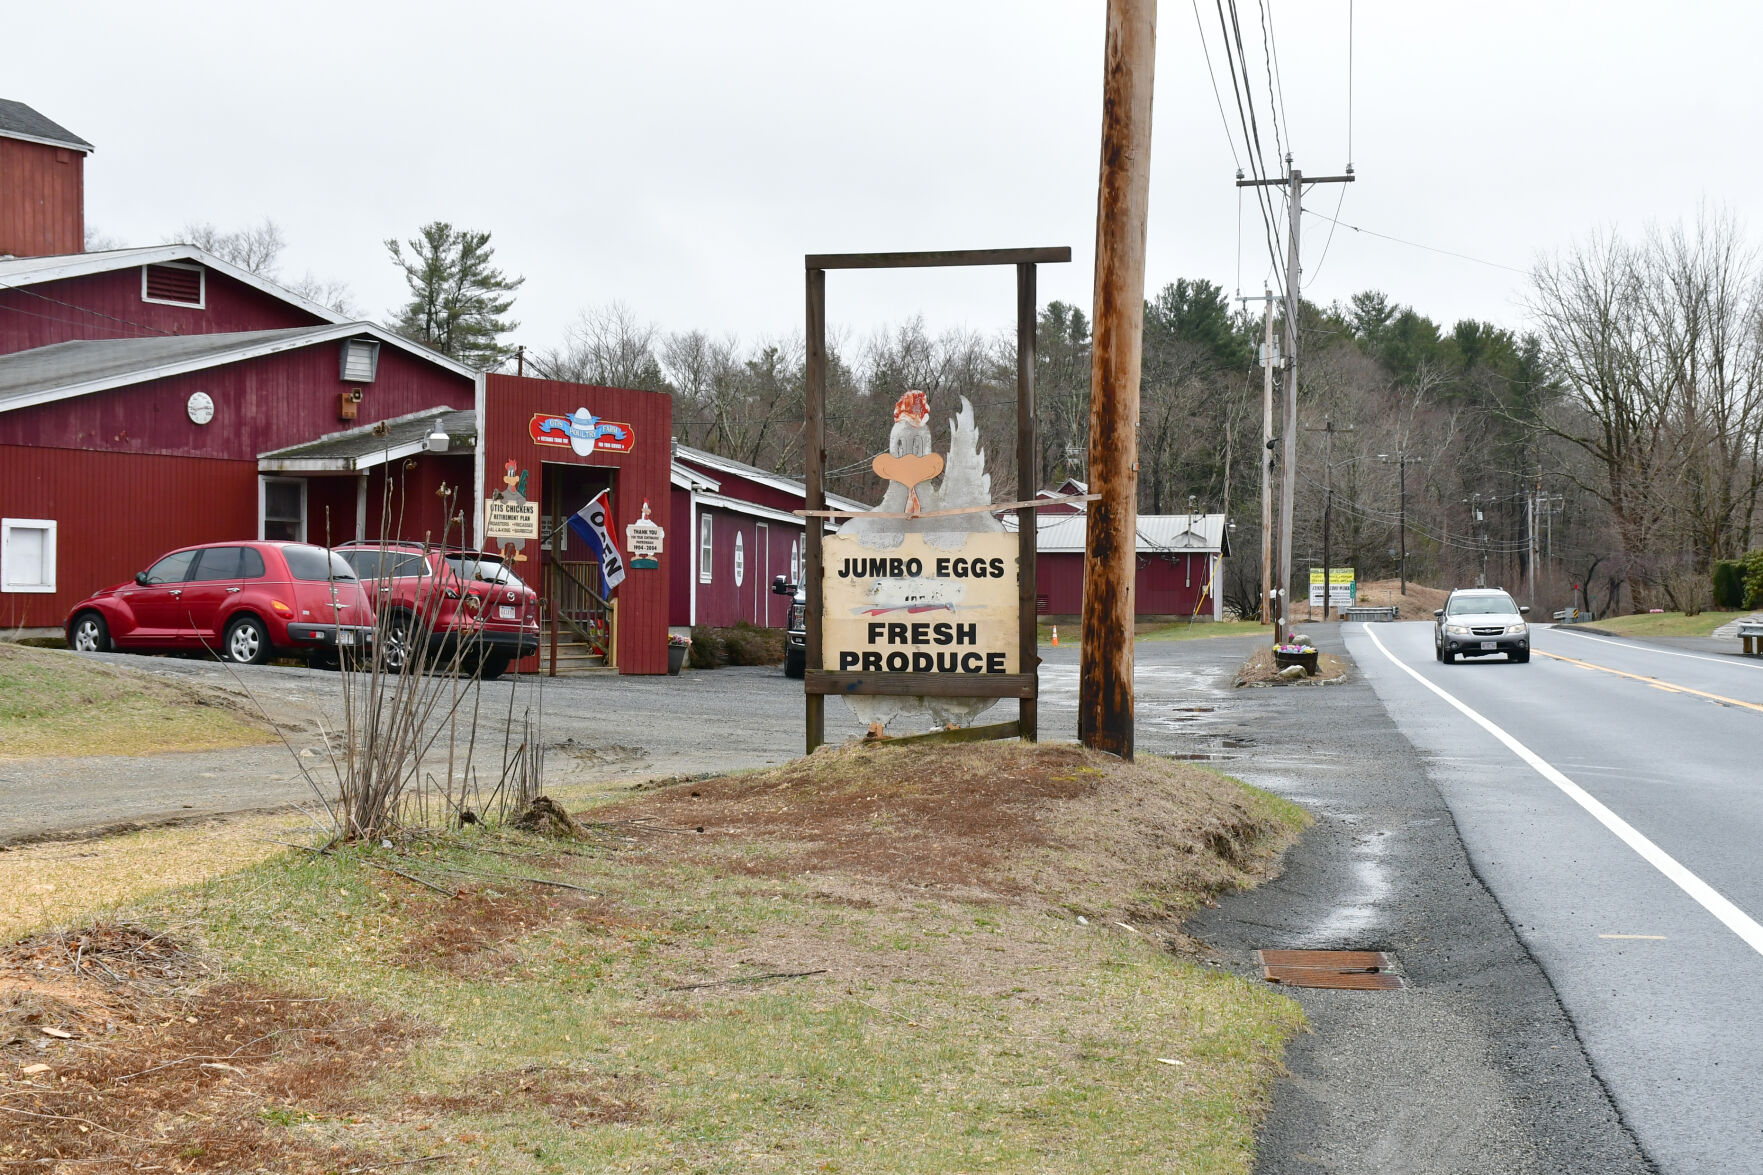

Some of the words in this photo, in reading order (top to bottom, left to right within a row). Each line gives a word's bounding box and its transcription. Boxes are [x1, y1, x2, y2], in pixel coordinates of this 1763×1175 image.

[570, 428, 596, 438] POULTRY
[506, 505, 534, 514] CHICKENS
[838, 558, 922, 578] JUMBO
[936, 558, 1004, 578] EGGS
[867, 622, 977, 645] FRESH
[840, 651, 1006, 673] PRODUCE
